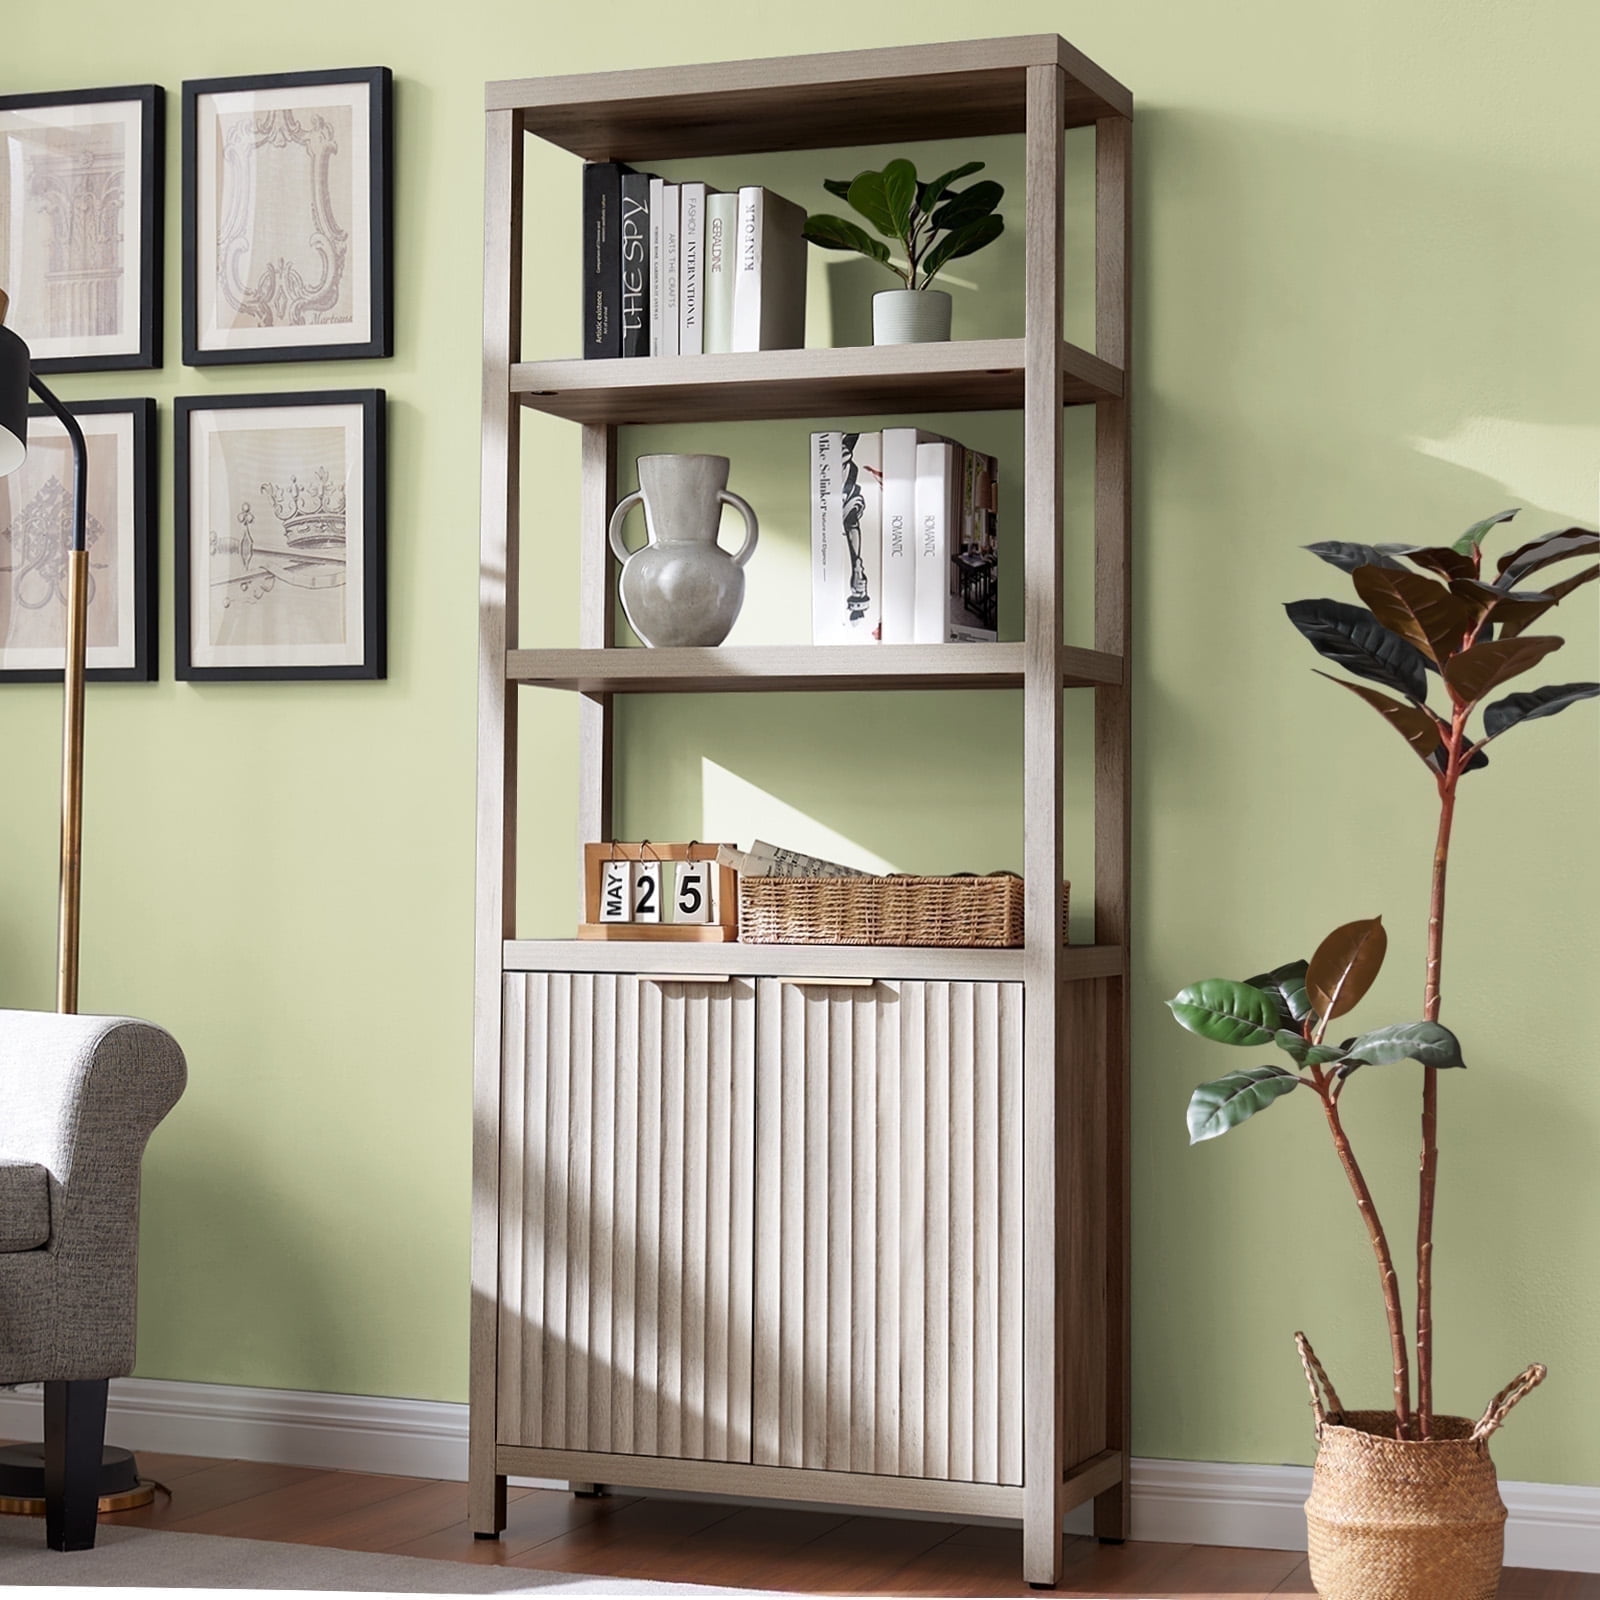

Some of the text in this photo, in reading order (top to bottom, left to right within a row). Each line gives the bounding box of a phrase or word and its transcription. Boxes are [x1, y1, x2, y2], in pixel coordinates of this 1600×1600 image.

[622, 197, 648, 263] SPY
[711, 218, 723, 273] GERALDINE
[744, 204, 755, 271] KINFOLK
[668, 233, 676, 309] ARTS THE CRAFTS
[686, 197, 697, 329] FASHION INTERNATIONAL
[595, 322, 603, 344] Artistic
[818, 432, 829, 460] Mike
[819, 463, 831, 511] Selinker
[891, 515, 903, 557] ROMANTIC
[924, 515, 936, 557] ROMANTIC
[606, 874, 623, 916] MAY
[635, 875, 702, 914] 2 5
